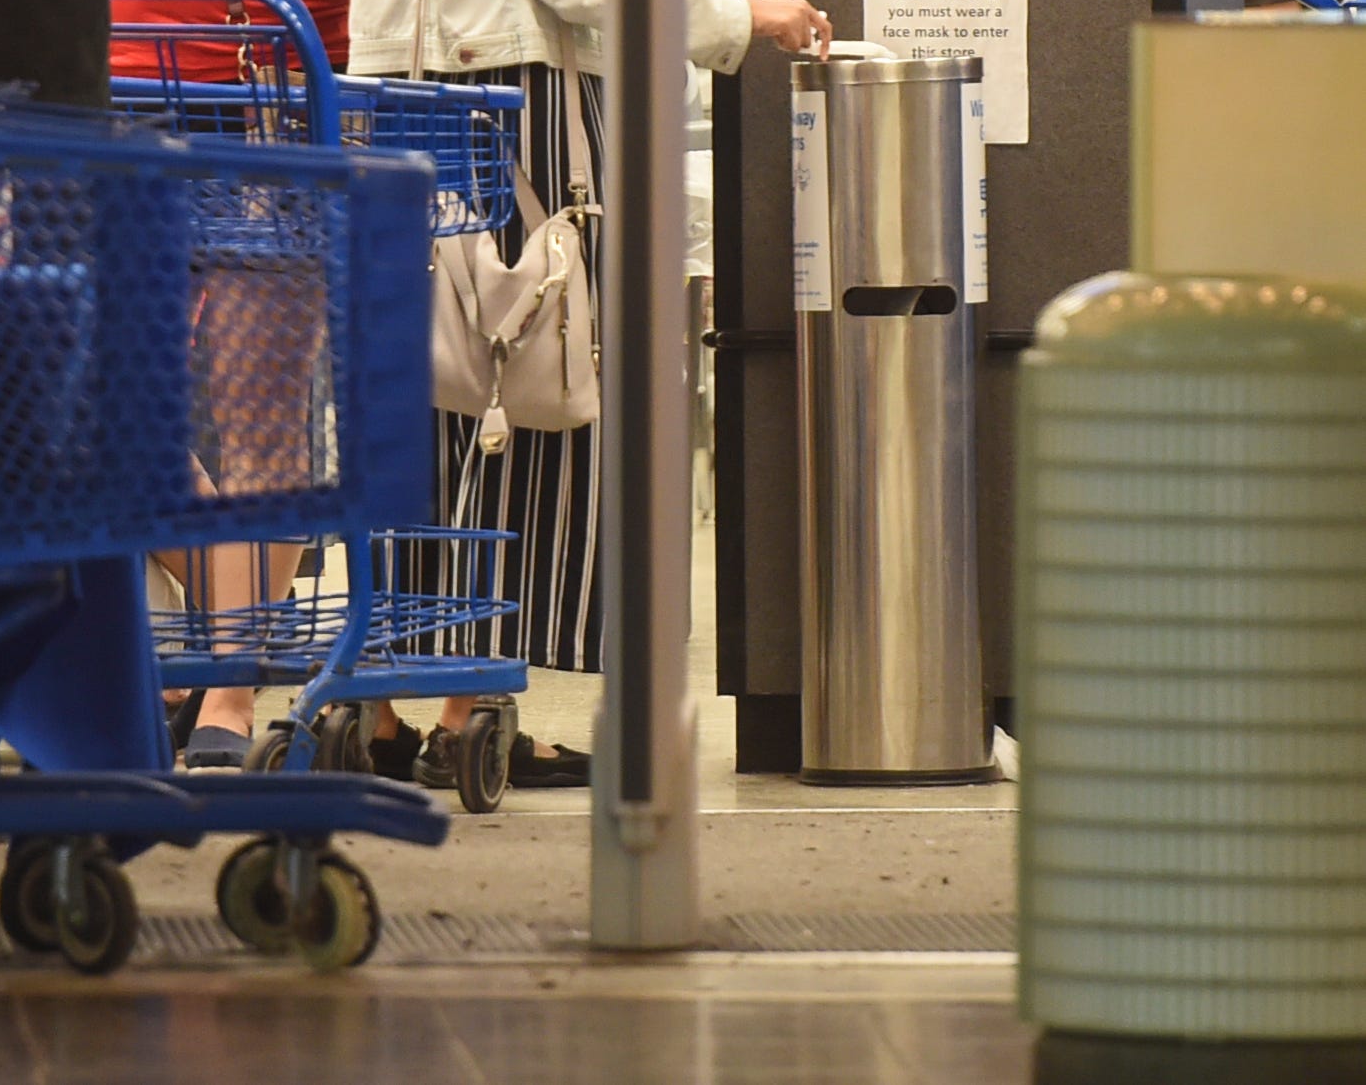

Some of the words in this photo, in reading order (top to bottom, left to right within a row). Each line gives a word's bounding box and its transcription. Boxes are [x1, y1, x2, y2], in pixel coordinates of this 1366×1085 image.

[888, 6, 914, 20] you
[918, 6, 952, 18] must
[955, 7, 990, 18] wear
[994, 7, 1002, 18] a
[882, 24, 910, 39] face
[914, 24, 950, 39] mask
[954, 26, 969, 39] to
[972, 26, 1009, 39] enter
